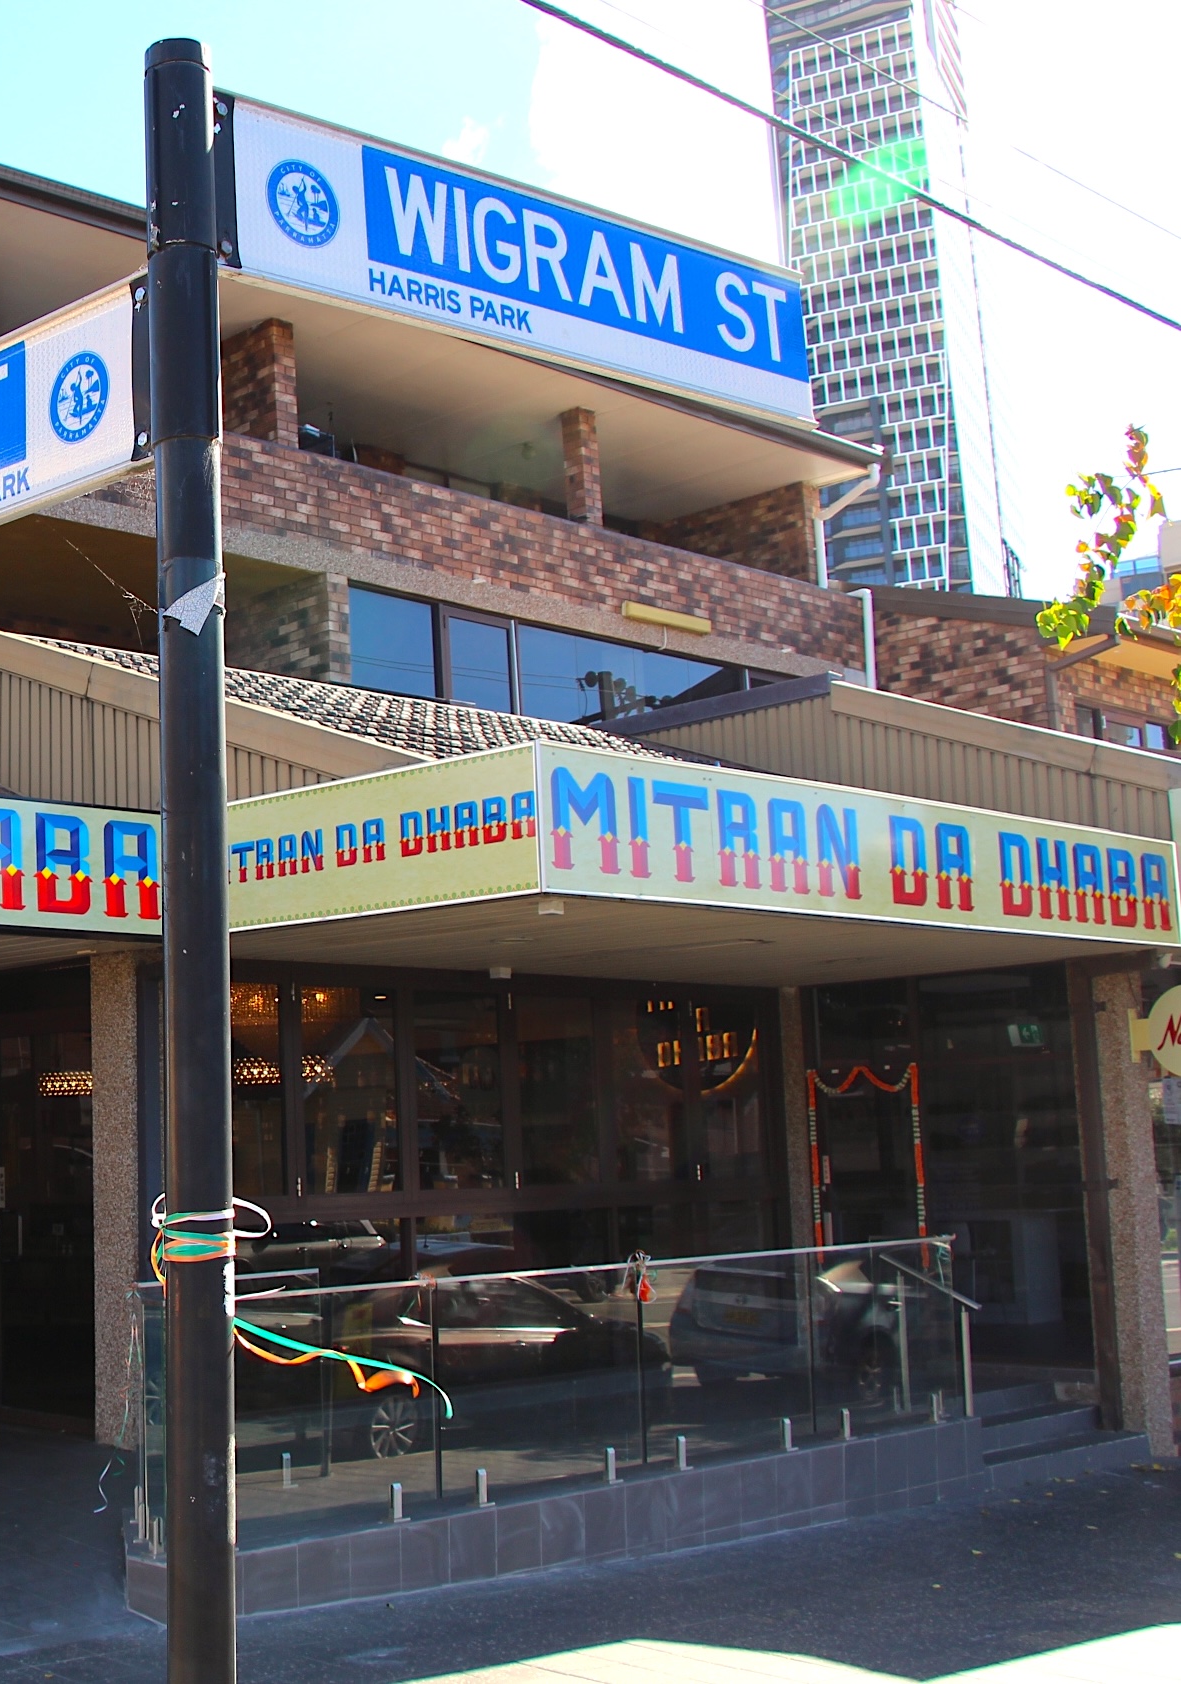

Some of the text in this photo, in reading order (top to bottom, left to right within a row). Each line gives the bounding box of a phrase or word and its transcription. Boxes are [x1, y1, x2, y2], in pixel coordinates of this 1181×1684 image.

[279, 164, 322, 183] CITY OF
[273, 210, 336, 244] PARRAMATTA
[384, 166, 787, 363] WIGRAM ST
[368, 267, 533, 334] HARRIS PARK
[60, 356, 95, 379] CITY OF
[53, 399, 106, 439] PARRAMATTA
[228, 790, 536, 885] TRAN DA DHABA
[550, 765, 1174, 931] MITRAN DA DHABA
